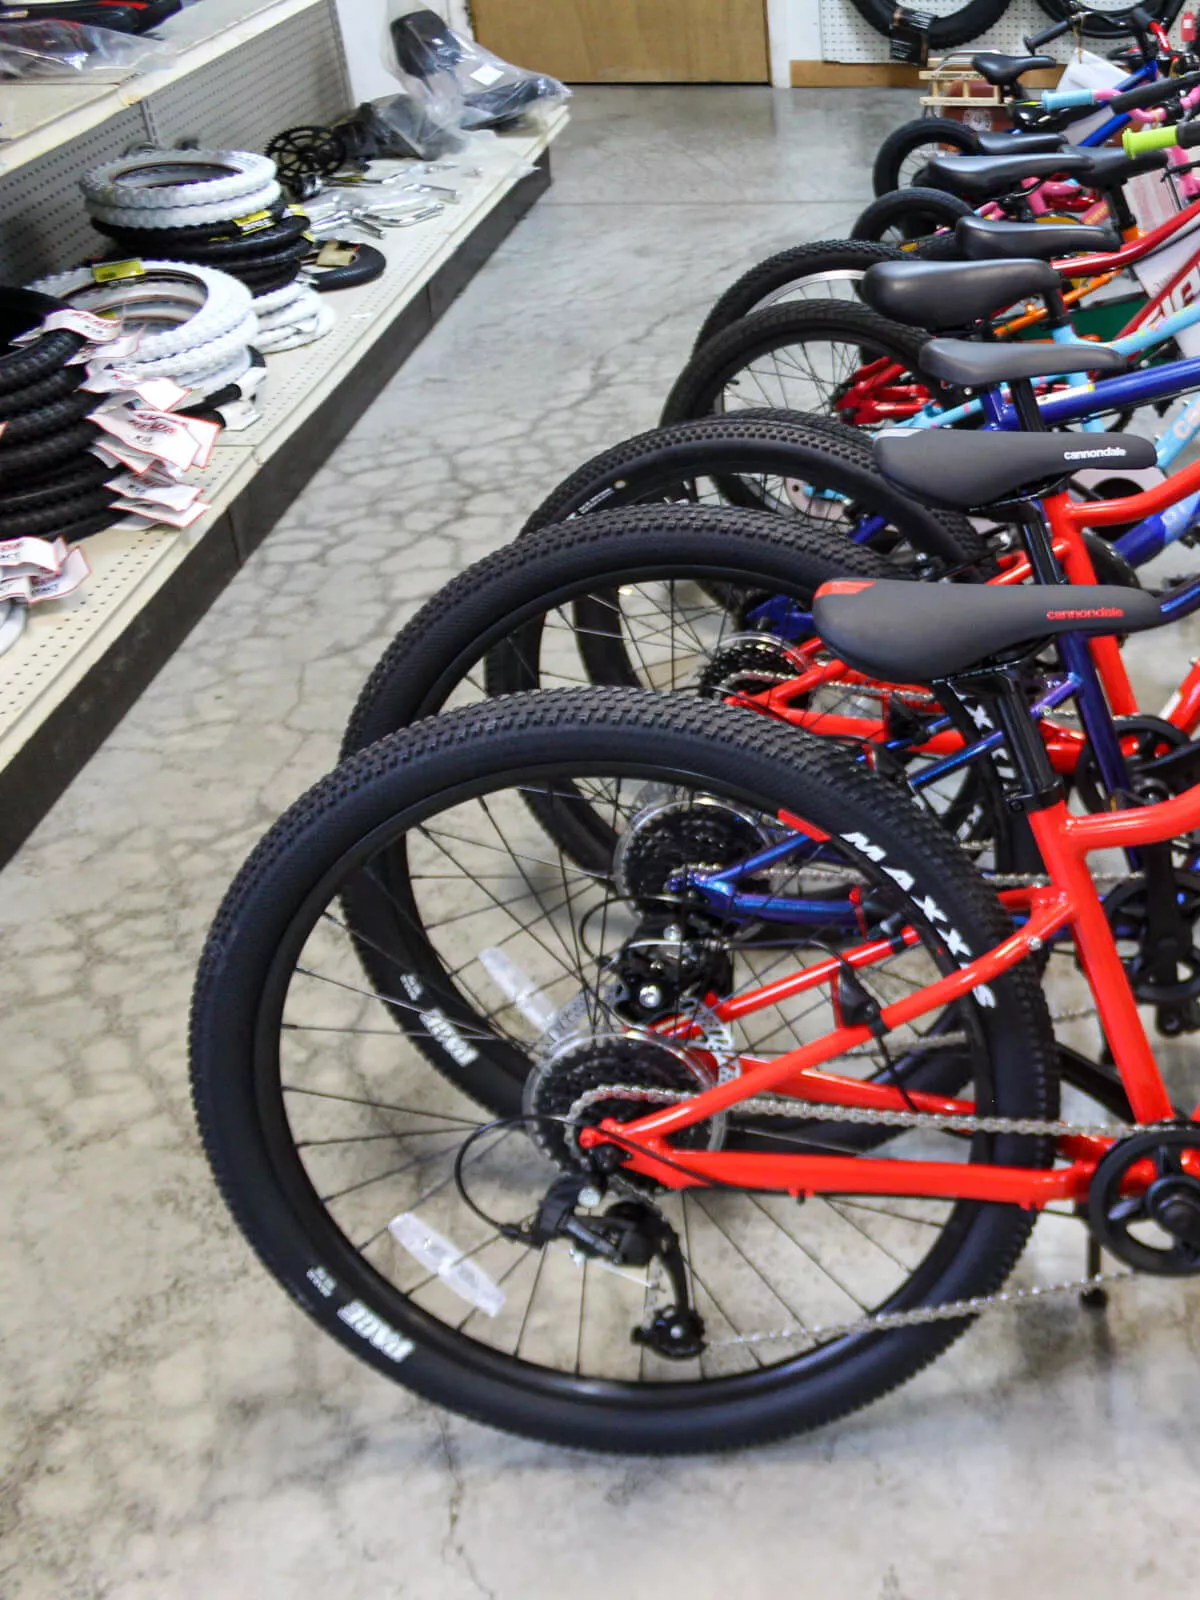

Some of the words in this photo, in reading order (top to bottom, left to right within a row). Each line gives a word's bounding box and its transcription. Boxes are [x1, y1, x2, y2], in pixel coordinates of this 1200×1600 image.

[1063, 446, 1127, 460] cannondale
[1046, 606, 1124, 620] cannondale
[839, 831, 997, 1009] MAXXS
